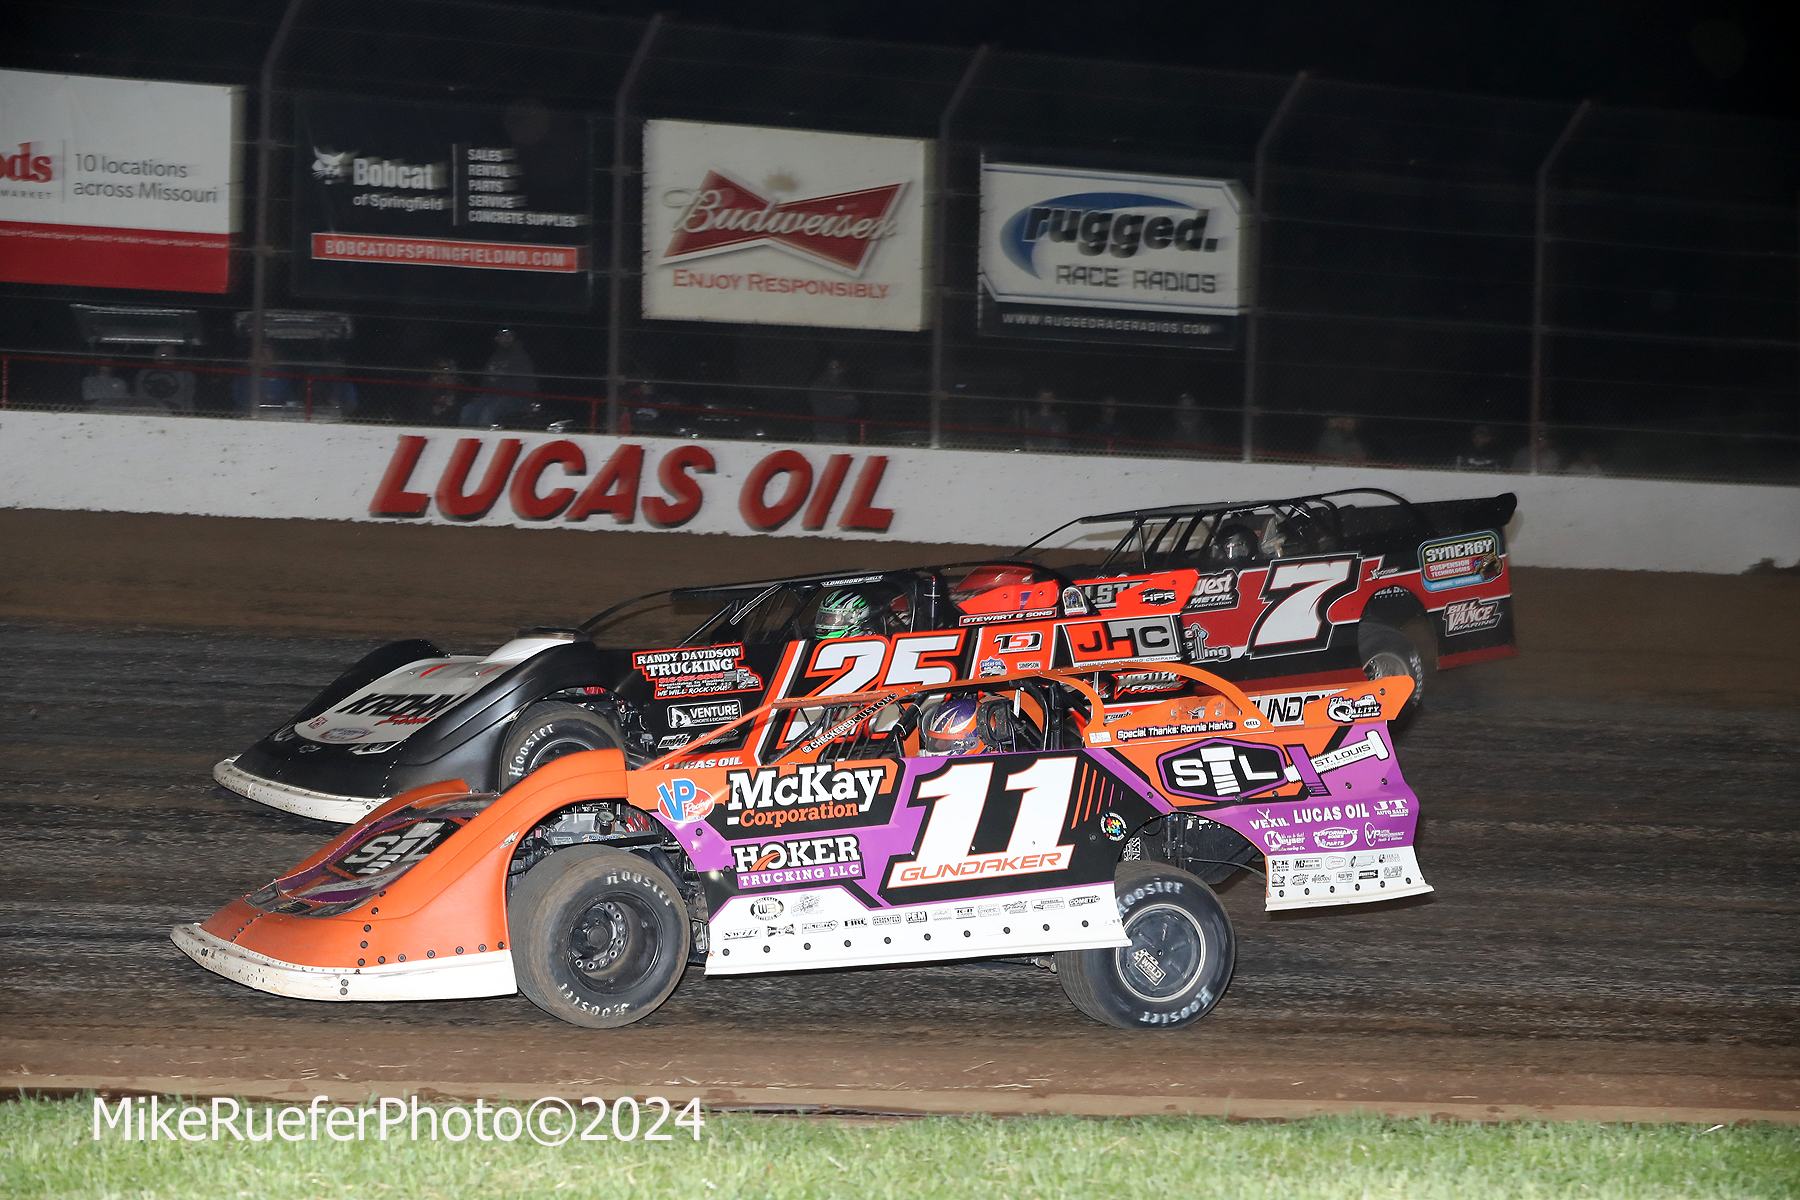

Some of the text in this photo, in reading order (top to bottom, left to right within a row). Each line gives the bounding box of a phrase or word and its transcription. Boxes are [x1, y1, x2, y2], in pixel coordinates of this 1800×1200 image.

[467, 148, 503, 161] SALES
[74, 154, 187, 178] 10 locations
[353, 158, 434, 190] Bobcat
[468, 164, 509, 178] RENTAL
[1, 189, 51, 199] MARKET
[74, 181, 218, 203] across Missouri
[468, 179, 503, 192] PARTS
[353, 194, 443, 212] of Springfield
[468, 194, 514, 208] SERVICE
[468, 209, 577, 227] CONCRETE SUPPLIES
[662, 188, 898, 239] Budweiser
[325, 240, 565, 267] BOBCATOFSPRINGFIELDMO.COM
[672, 269, 890, 299] ENJOY RESPONSIBLY
[1056, 264, 1216, 294] RACE RADIOS
[368, 435, 894, 533] LUCAS OIL
[1425, 539, 1493, 562] SYNERGY
[1429, 559, 1470, 572] SUSPENSION
[1431, 566, 1471, 578] TECHNOLOGIES
[1142, 592, 1175, 602] HPR
[1190, 594, 1233, 605] METAL
[1254, 559, 1352, 646] 7
[1447, 601, 1478, 614] BILL
[963, 613, 1013, 624] STEWART
[1025, 610, 1054, 618] SONS
[1448, 605, 1494, 631] VANCE
[1077, 622, 1170, 657] JHC
[637, 647, 740, 665] RANDY DAVIDSON
[646, 658, 734, 677] TRUCKING
[690, 704, 738, 719] VENTURE
[1117, 729, 1146, 741] Special
[1148, 726, 1179, 735] Thanks:
[1180, 722, 1207, 733] Ronnie
[1208, 720, 1234, 731] Hanks
[508, 723, 554, 777] Hoosier
[1315, 744, 1371, 767] ST. LOUIS
[718, 757, 743, 767] OIL
[728, 765, 884, 813] McKay
[658, 779, 696, 821] VP
[685, 799, 711, 816] Racing
[1373, 799, 1408, 811] JT
[740, 802, 859, 828] Corporation
[887, 757, 1078, 888] 11
[1293, 803, 1370, 823] LUCAS OIL
[1313, 829, 1358, 837] PERFORMANCE
[733, 835, 861, 873] HOKER
[741, 863, 860, 887] TRUCKING LLC
[900, 852, 1062, 882] GUNDAKER
[1142, 957, 1162, 978] WELD
